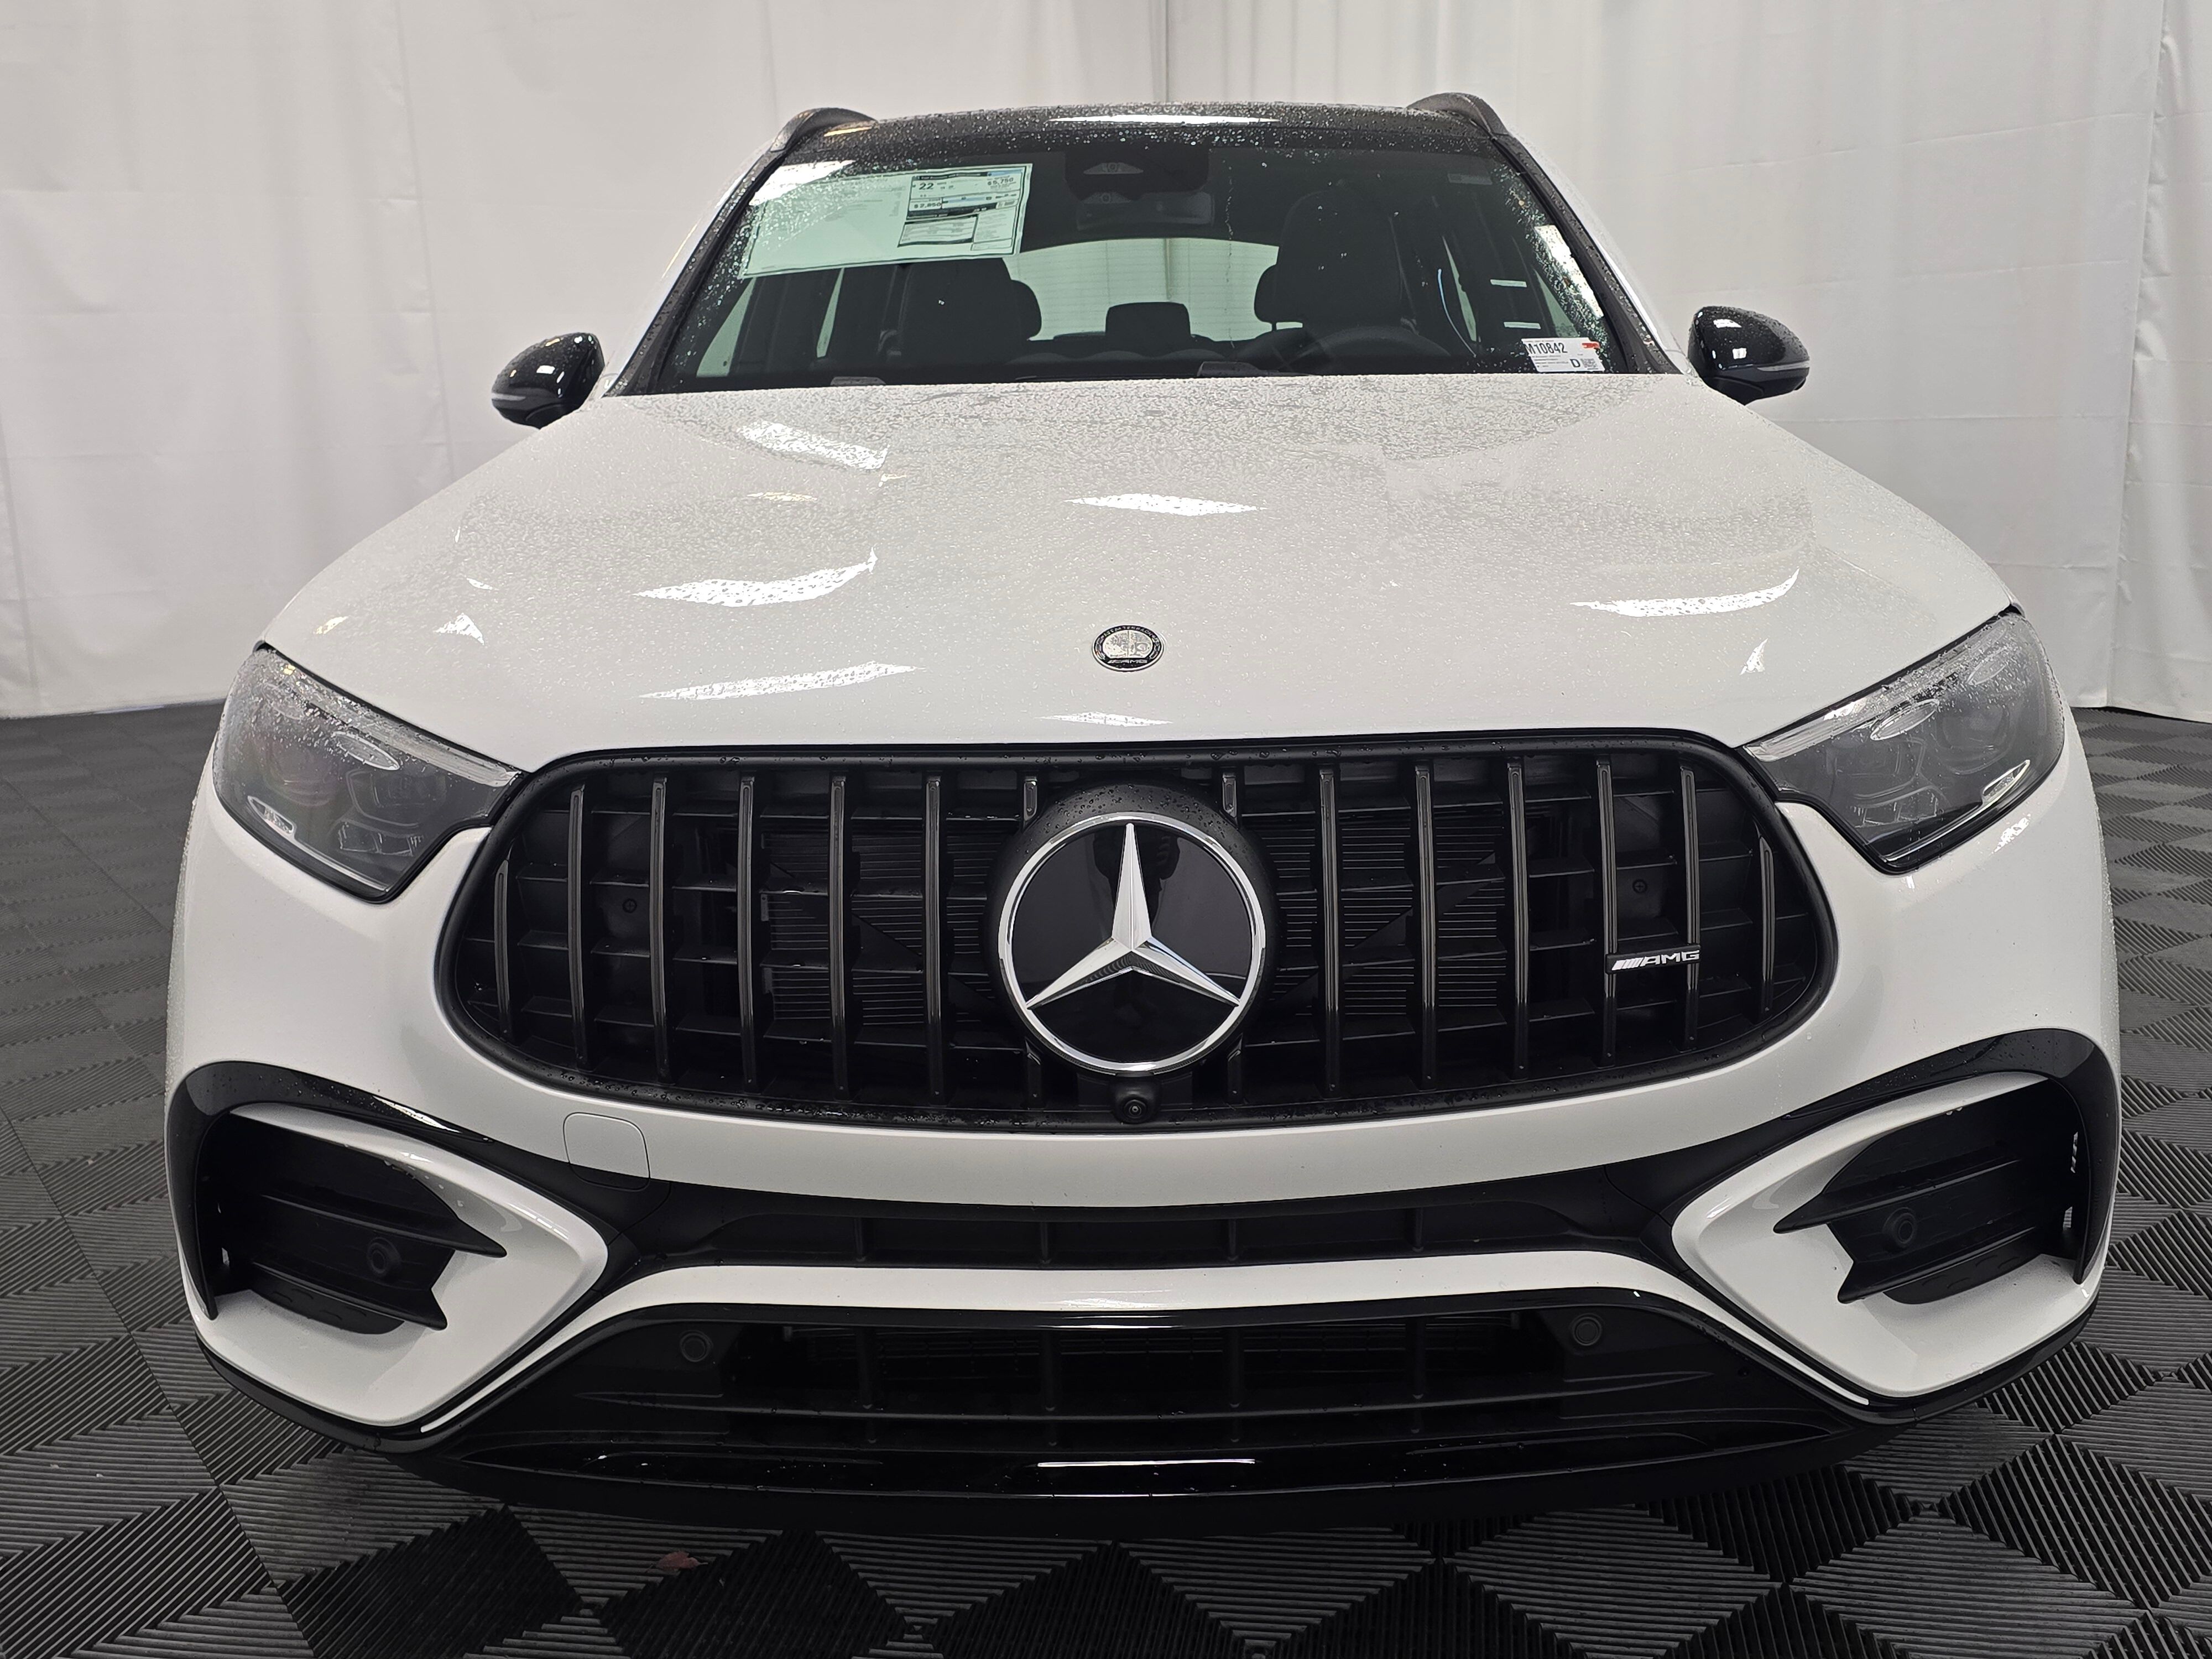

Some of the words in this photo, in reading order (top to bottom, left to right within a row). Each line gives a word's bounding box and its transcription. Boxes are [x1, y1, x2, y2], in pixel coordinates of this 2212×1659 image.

[919, 182, 934, 190] 22
[1569, 358, 1581, 368] D
[1640, 950, 1700, 967] AMG
